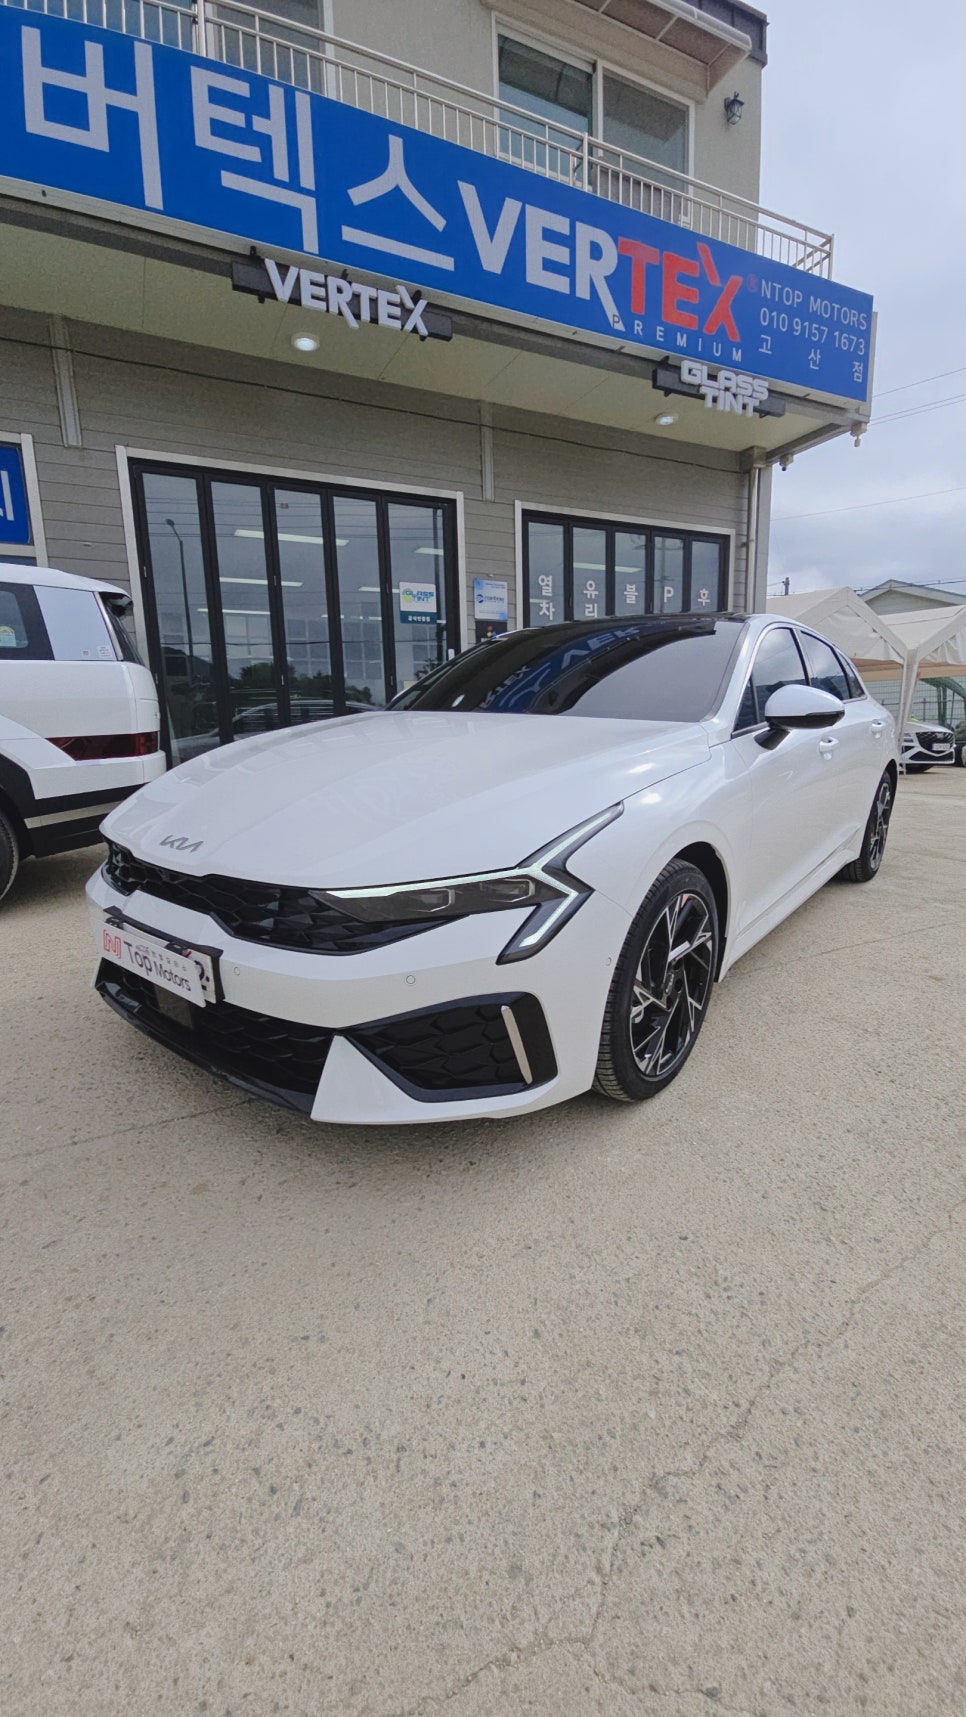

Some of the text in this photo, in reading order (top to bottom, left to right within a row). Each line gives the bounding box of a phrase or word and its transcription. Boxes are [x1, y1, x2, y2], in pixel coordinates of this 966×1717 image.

[21, 25, 743, 342] 버텍스 VERTEX
[264, 258, 428, 336] VERTEX
[761, 279, 867, 330] NTOP MOTORS
[612, 314, 742, 362] PREMIUM
[760, 307, 865, 355] 010 9157 1673
[680, 359, 769, 401] GLASS
[701, 386, 760, 418] TINT
[123, 940, 153, 976] Top
[153, 961, 191, 991] Motors
